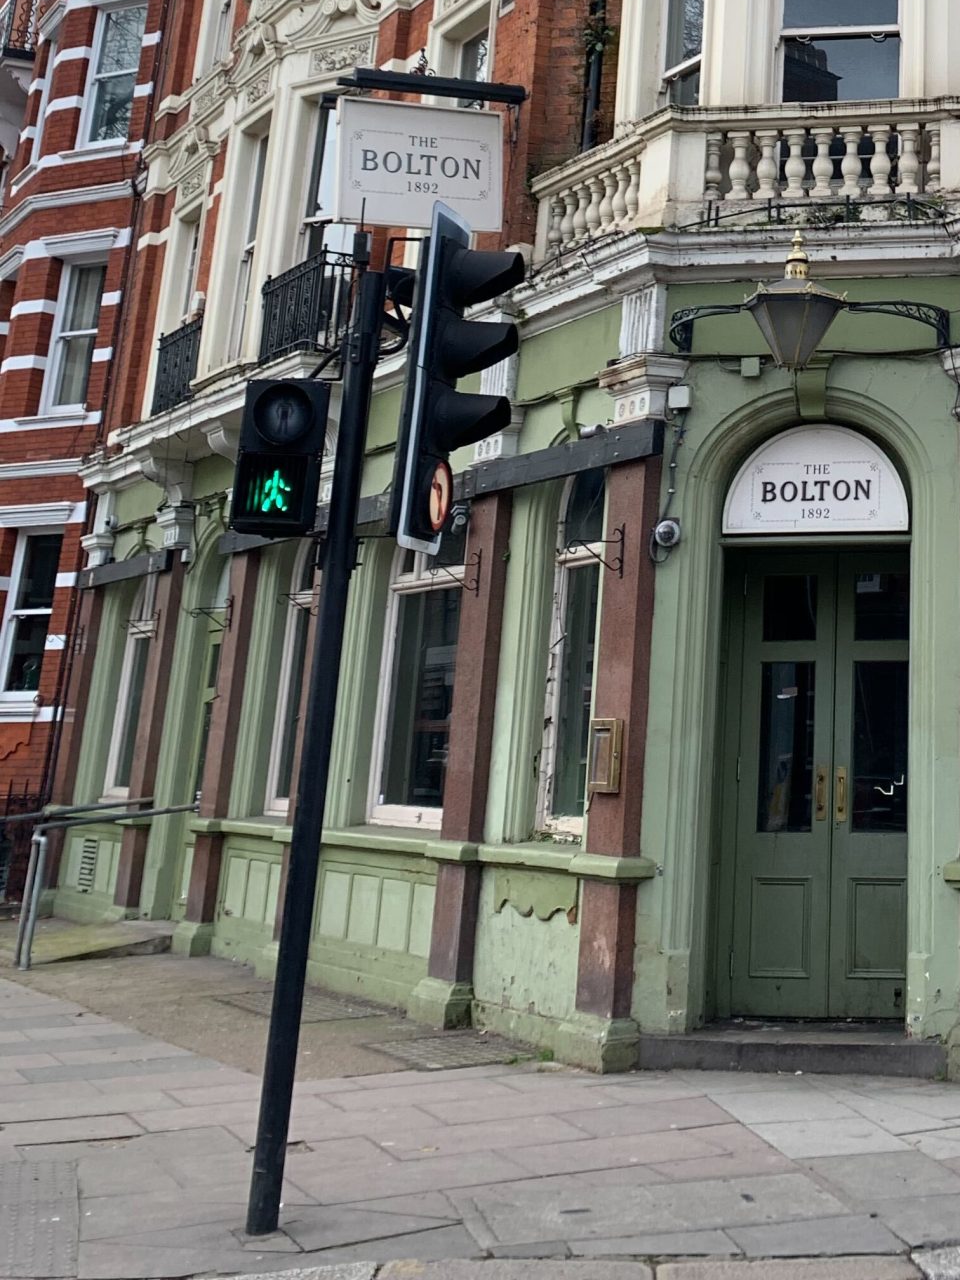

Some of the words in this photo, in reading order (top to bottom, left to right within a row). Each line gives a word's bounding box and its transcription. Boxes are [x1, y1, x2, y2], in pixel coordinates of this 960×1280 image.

[408, 135, 438, 149] THE
[361, 149, 481, 180] BOLTON
[407, 181, 439, 194] 1892
[803, 464, 831, 475] THE
[761, 479, 872, 503] BOLTON
[801, 508, 831, 519] 1892
